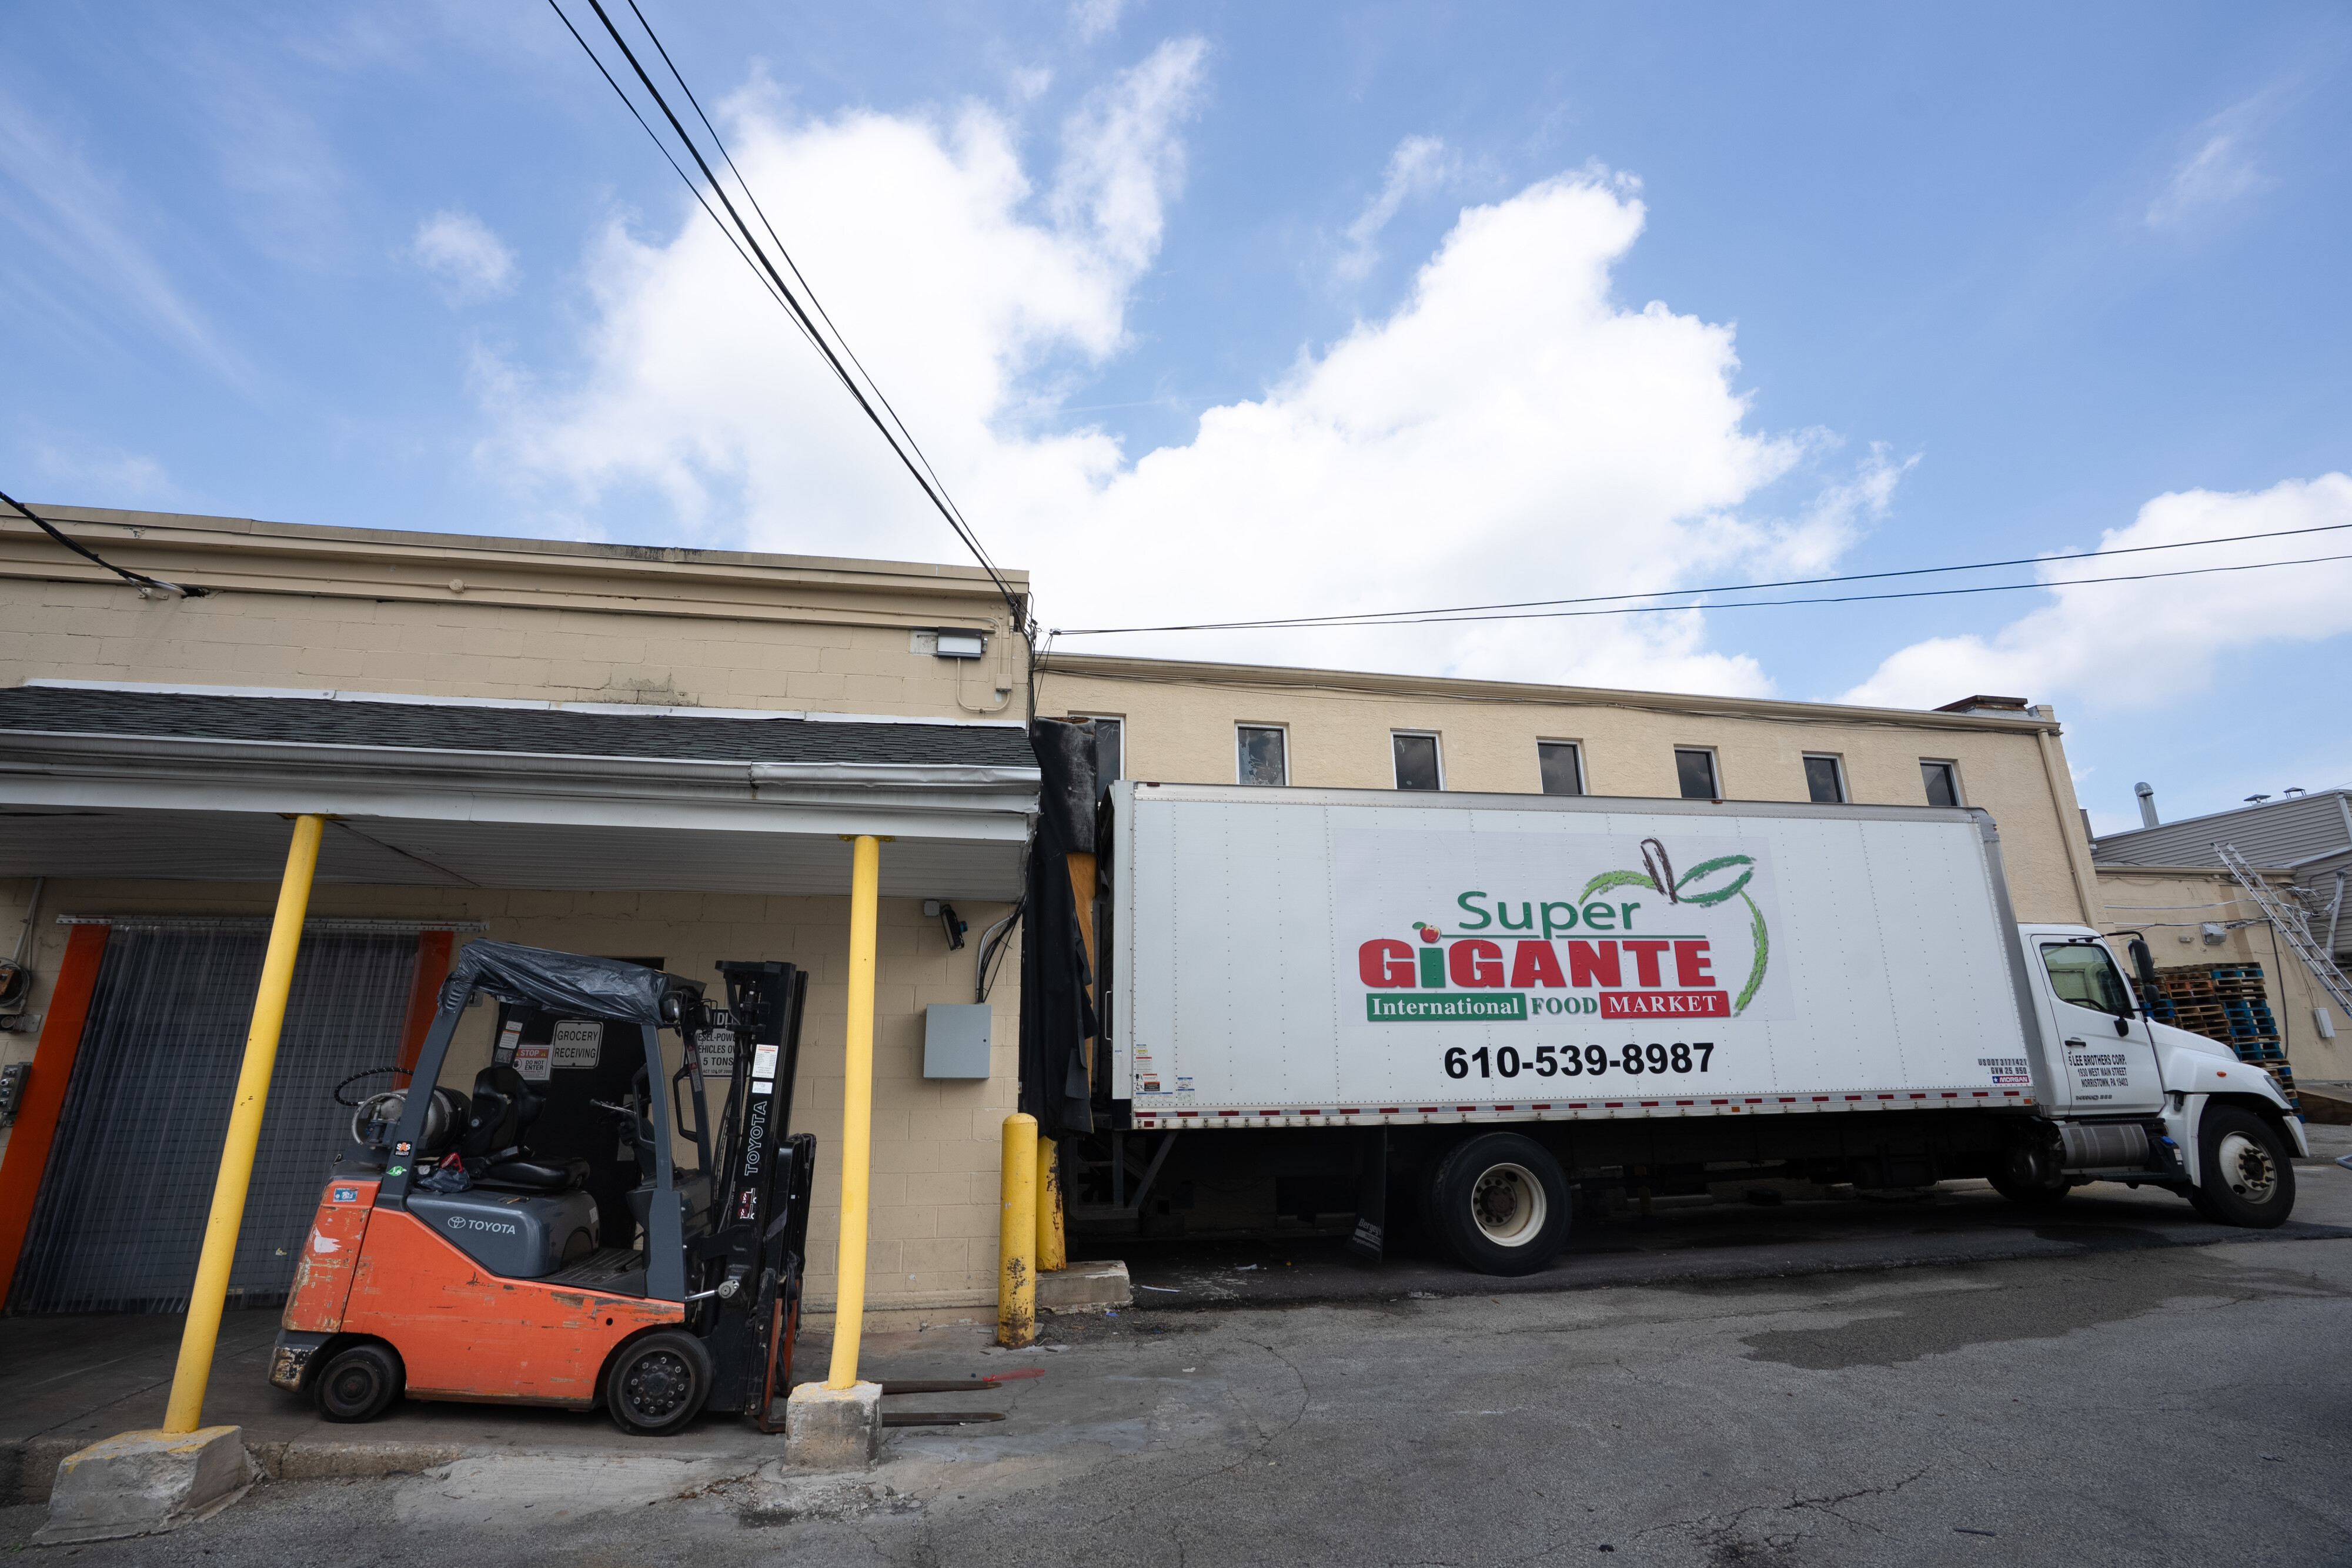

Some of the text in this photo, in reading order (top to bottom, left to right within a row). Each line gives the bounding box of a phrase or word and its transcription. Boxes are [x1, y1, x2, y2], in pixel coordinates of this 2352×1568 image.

[1457, 891, 1641, 940] Super
[1372, 995, 1718, 1015] International FOOD MARKET
[557, 1030, 599, 1041] GROCERY
[554, 1048, 596, 1058] RECEIVING
[698, 1045, 726, 1054] EHICLES
[703, 1057, 734, 1066] 5 TONS
[1444, 1042, 1715, 1079] 610-539-8987
[2072, 1055, 2083, 1066] LEE
[2083, 1054, 2112, 1066] BROTHERS
[2112, 1054, 2127, 1065] CORP.
[2077, 1067, 2127, 1077] 1930 WEST MAIN STREET
[2110, 1078, 2116, 1086] PA
[744, 1101, 767, 1176] TOYOTA
[396, 1142, 411, 1151] SAS
[468, 1219, 516, 1235] TOYOTA
